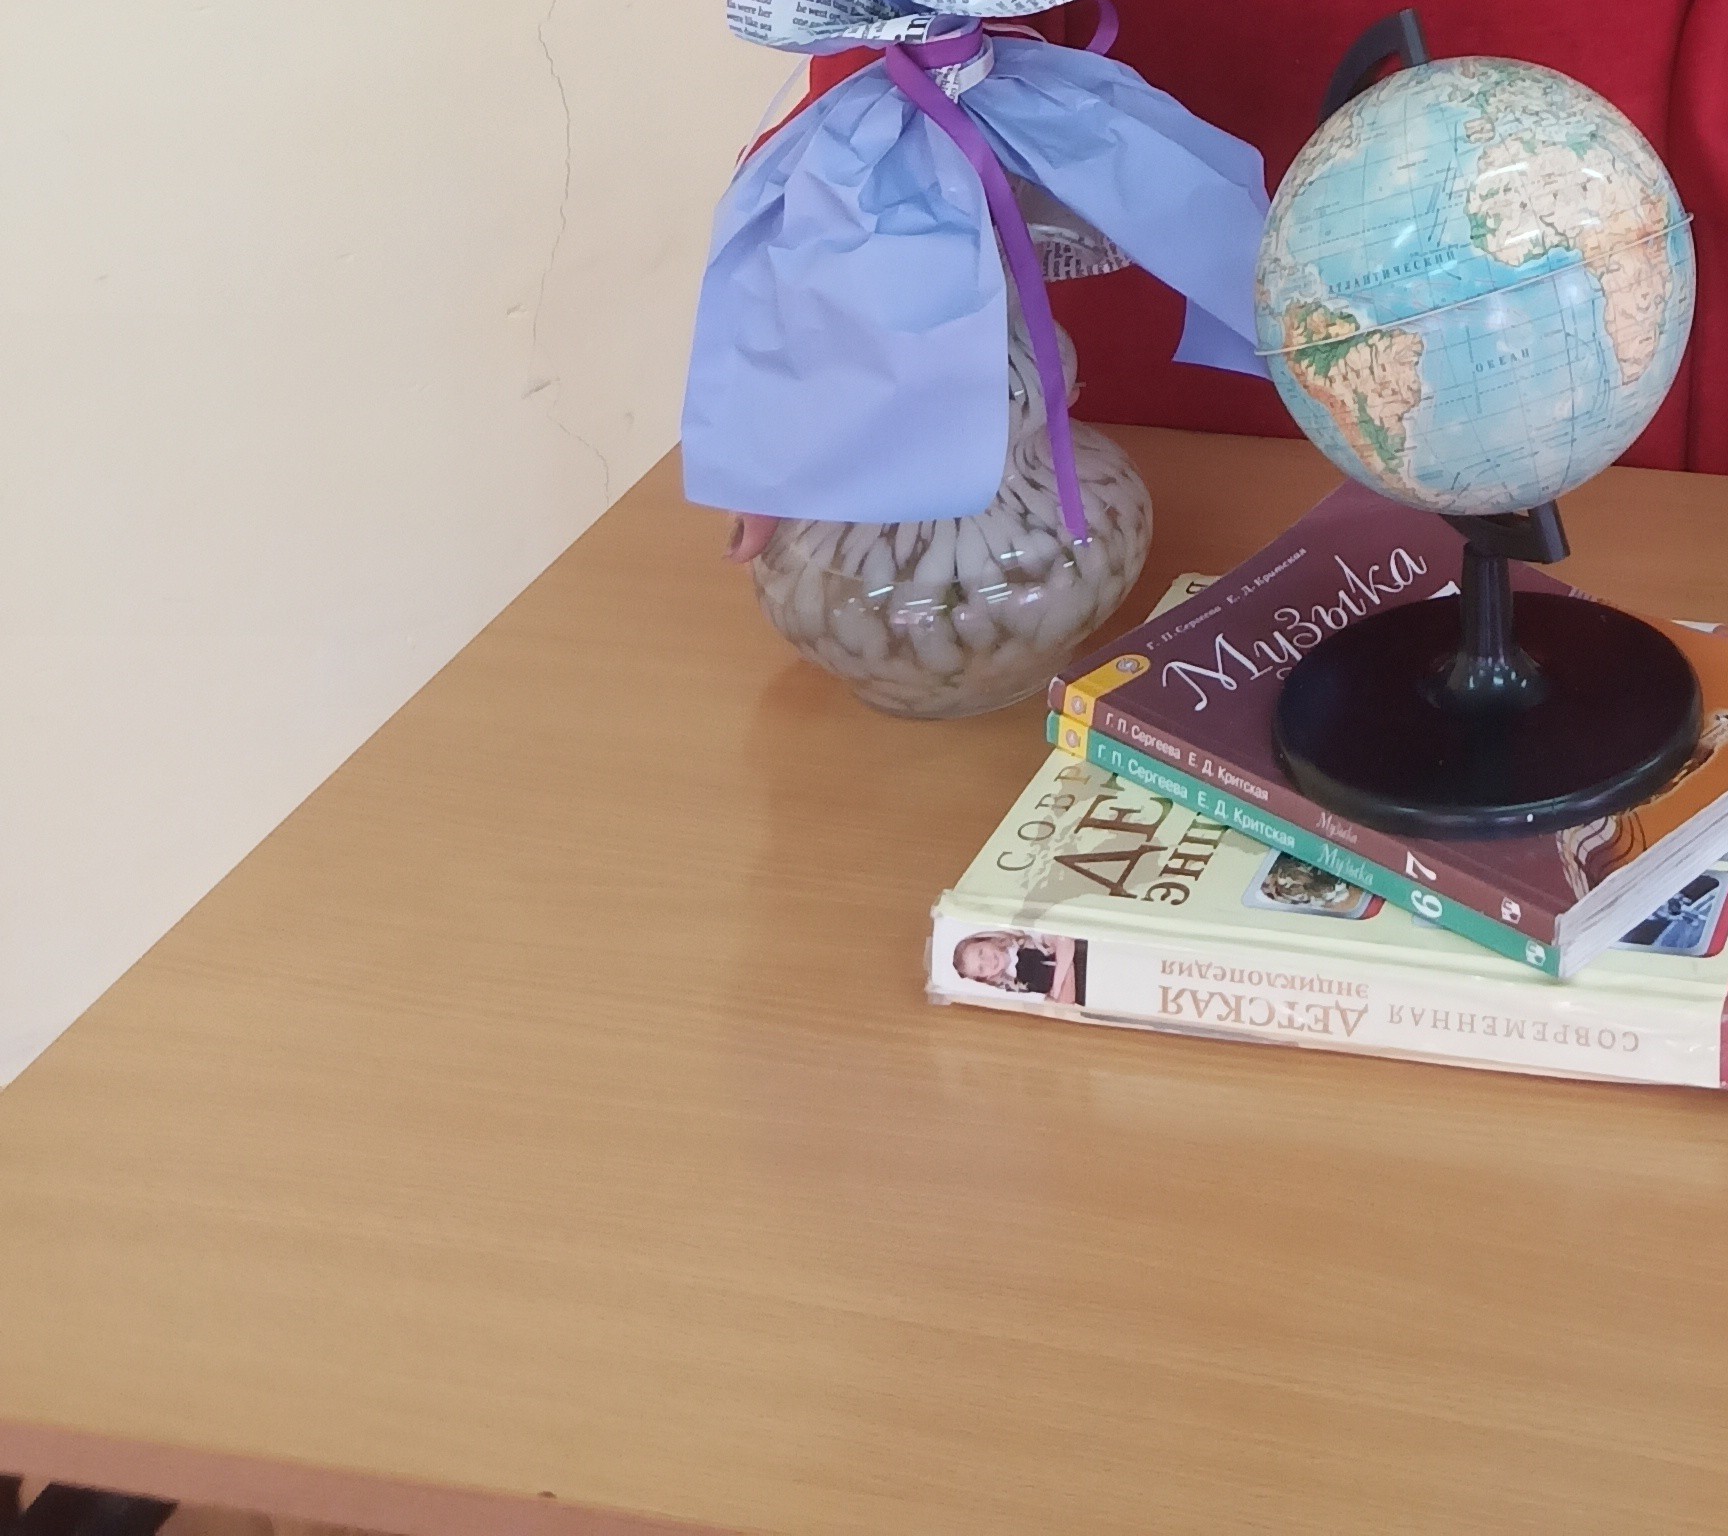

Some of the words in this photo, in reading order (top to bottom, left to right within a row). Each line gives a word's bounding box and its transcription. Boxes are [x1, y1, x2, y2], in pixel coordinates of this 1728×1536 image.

[1475, 348, 1530, 373] ОКЕАН
[1162, 547, 1428, 711] Музыка
[1106, 712, 1114, 728] Г.
[1117, 717, 1129, 735] П.
[1131, 724, 1181, 760] Сергеева
[1188, 752, 1199, 768] Е.
[1202, 759, 1215, 778] Д.
[1217, 766, 1270, 802] Критская
[1405, 851, 1437, 881] 7
[1097, 743, 1107, 761] Г.
[1112, 750, 1125, 770] П.
[1127, 758, 1188, 800] Сергеева
[1197, 790, 1210, 809] Е.
[1214, 799, 1230, 819] Д.
[1233, 806, 1296, 848] Критская
[1317, 843, 1374, 886] Музыка
[1410, 889, 1443, 919] 6
[1160, 957, 1370, 1000] ЭНЦИКЛОПЕДИЯ
[1158, 983, 1369, 1038] ДЕТСКАЯ
[1387, 1002, 1640, 1053] СОВРЕМЕННАЯ
